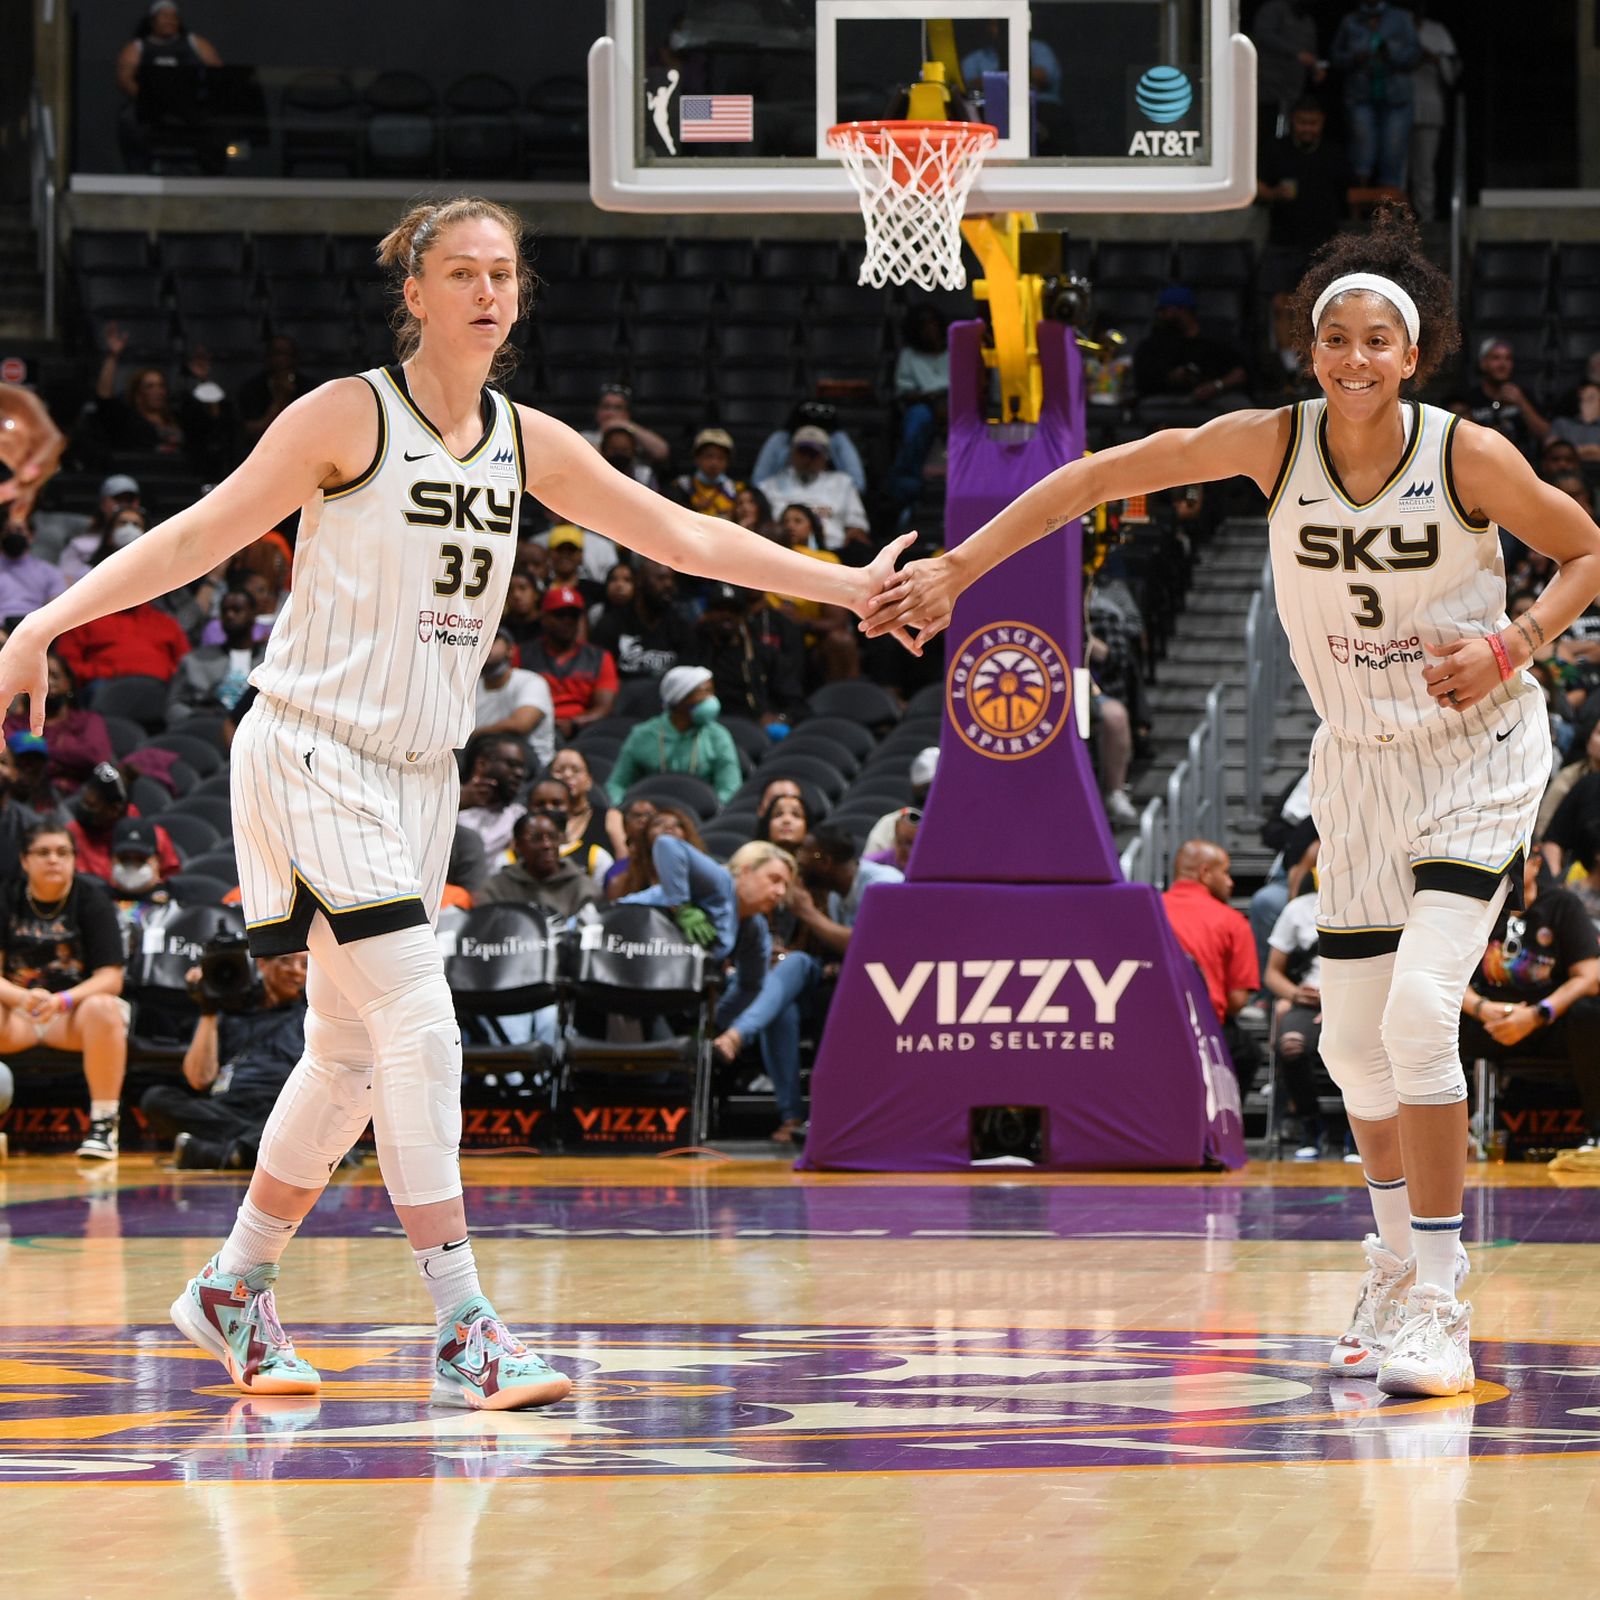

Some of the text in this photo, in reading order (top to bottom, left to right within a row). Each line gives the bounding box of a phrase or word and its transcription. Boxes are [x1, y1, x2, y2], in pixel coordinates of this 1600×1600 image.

[1128, 130, 1201, 157] AT&T
[401, 480, 516, 535] SKY
[1293, 522, 1441, 574] SKY
[433, 542, 493, 599] 33
[436, 612, 483, 631] UChicago
[1346, 582, 1385, 630] 3
[951, 627, 1066, 699] LOS ANGELES
[1354, 650, 1423, 670] Medicine
[965, 719, 1053, 753] SPARKS
[864, 959, 1140, 1025] VIZZY
[896, 1031, 1115, 1053] HARD SELTZER
[574, 1107, 687, 1133] VIZZY
